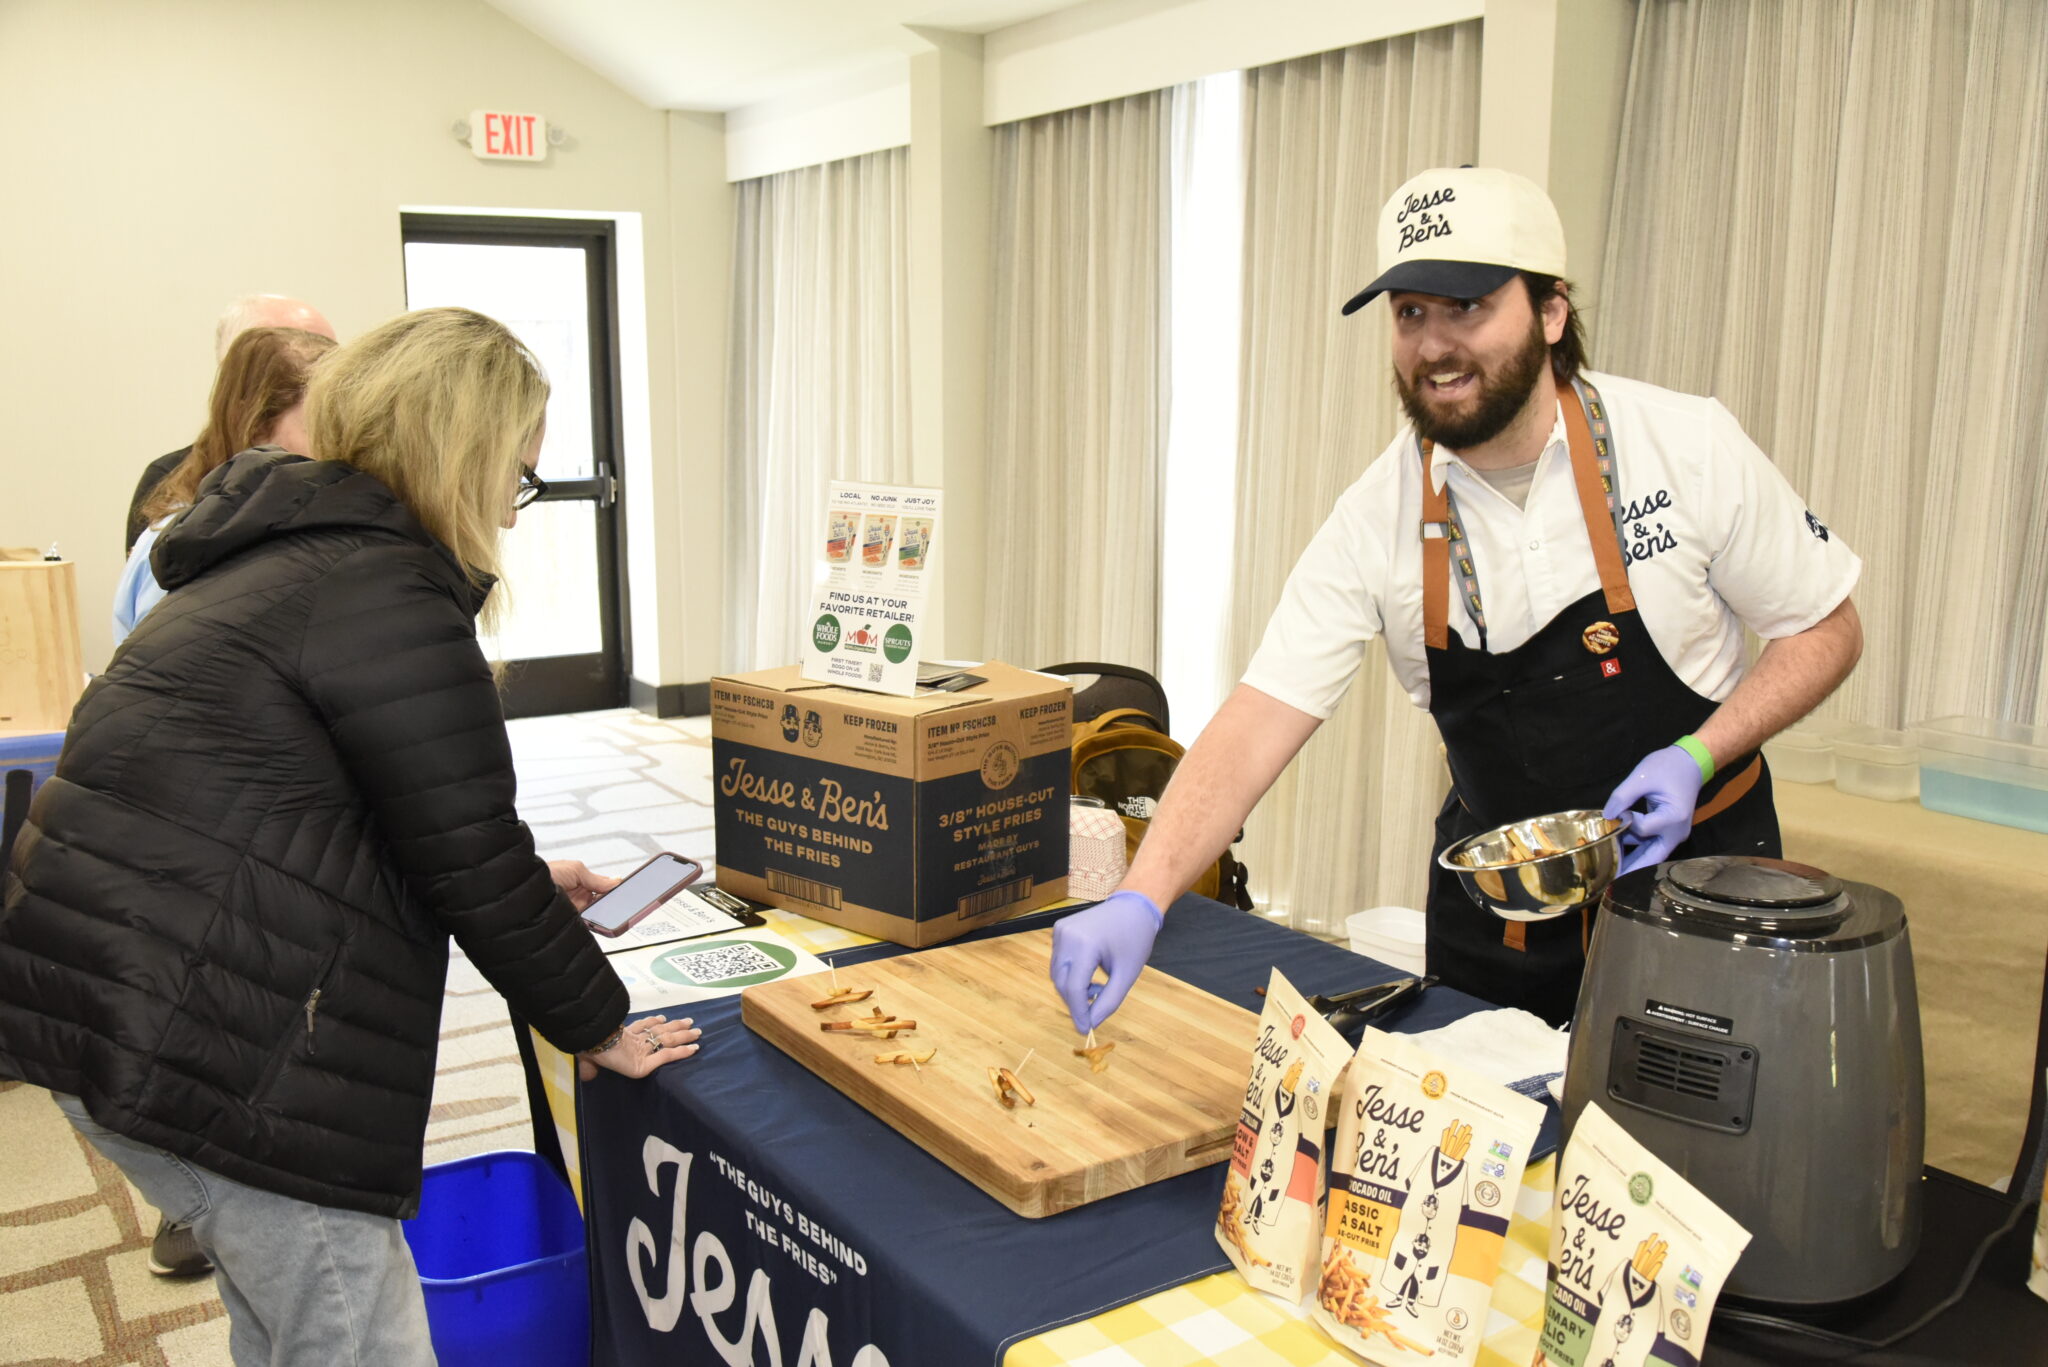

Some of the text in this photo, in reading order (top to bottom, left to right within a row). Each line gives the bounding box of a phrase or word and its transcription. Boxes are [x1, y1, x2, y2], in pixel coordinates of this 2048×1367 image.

[485, 113, 537, 156] EXIT
[1397, 187, 1456, 223] Jesse
[1420, 213, 1432, 225] &
[1398, 214, 1453, 253] Ben's
[840, 492, 862, 500] LOCAL
[1621, 489, 1672, 524] sse
[1633, 522, 1650, 538] &
[829, 591, 908, 609] FIND US AT YOUR
[820, 602, 915, 623] FAVORITE RETAILER!
[816, 624, 839, 634] WHOLE
[816, 632, 837, 642] FOODS
[885, 637, 912, 647] SPROUTS
[1605, 662, 1617, 674] &
[714, 689, 731, 702] ITEM
[1019, 701, 1066, 720] KEEP FROZEN
[843, 713, 897, 734] KEEP FROZEN
[927, 725, 948, 739] ITEM
[720, 756, 889, 831] Jesse & Ben's
[1127, 796, 1146, 804] THE
[938, 786, 1056, 828] 3/8" HOUSE-CUT
[1118, 801, 1146, 811] NORTH
[1125, 809, 1147, 818] FACE
[736, 808, 874, 855] THE GUYS BEHIND
[953, 807, 1042, 843] STYLE FRIES
[764, 836, 842, 868] THE FRIES
[953, 840, 1040, 872] RESTAURANT GUYS
[1255, 1024, 1289, 1069] Jesse
[1255, 1063, 1264, 1080] &
[1246, 1065, 1267, 1110] en's
[1356, 1084, 1425, 1134] Jesse
[1373, 1128, 1387, 1150] &
[1349, 1180, 1393, 1204] OCADO OIL
[709, 1150, 867, 1276] "THE GUYS BEHIND
[1344, 1199, 1379, 1221] ASSIC
[1561, 1174, 1626, 1240] Jesse
[1338, 1229, 1380, 1249] E-CUT FRIES
[1350, 1218, 1384, 1238] SALT
[1573, 1227, 1586, 1249] &
[626, 1135, 890, 1367] Jes
[745, 1208, 838, 1285] THE FRIES"
[1560, 1226, 1596, 1291] en's
[1553, 1287, 1587, 1317] CADO OIL
[1547, 1305, 1586, 1339] EMARY
[1545, 1322, 1566, 1346] LIC
[1554, 1347, 1575, 1366] FRIES
